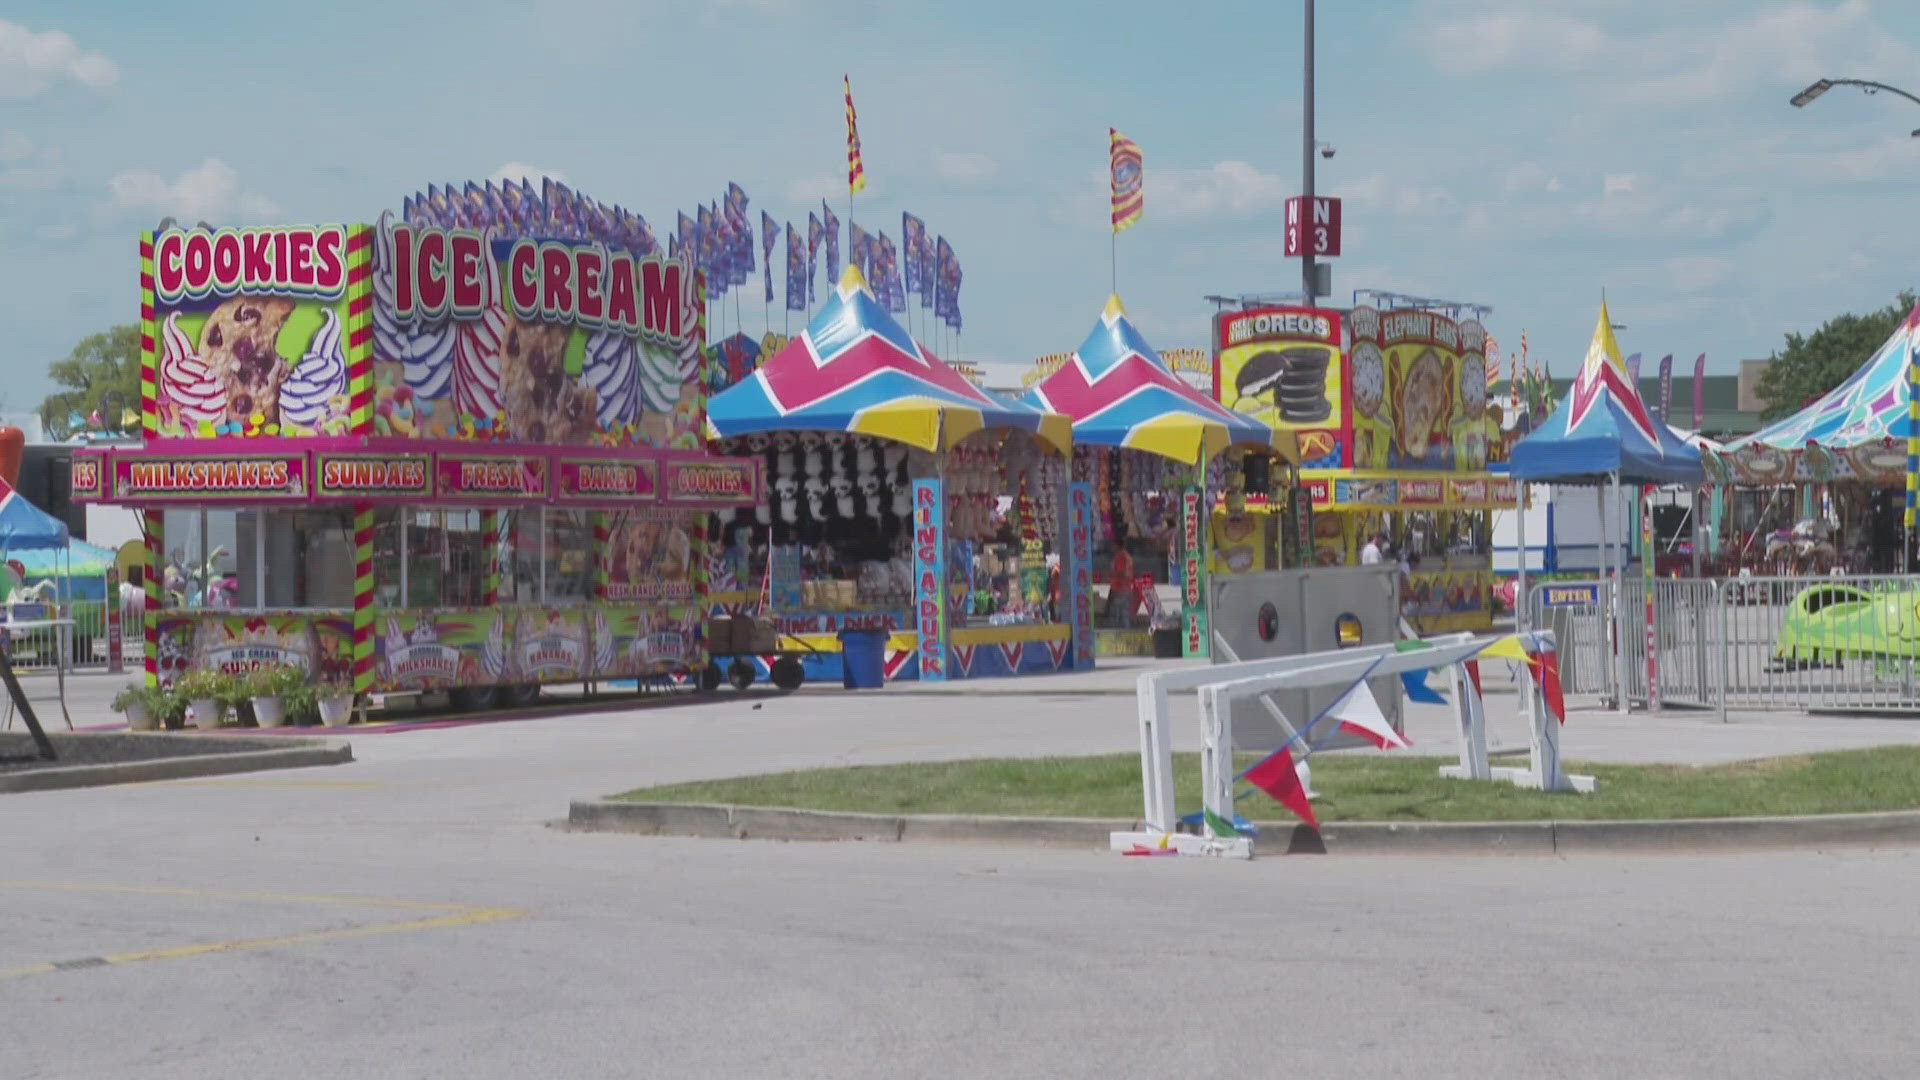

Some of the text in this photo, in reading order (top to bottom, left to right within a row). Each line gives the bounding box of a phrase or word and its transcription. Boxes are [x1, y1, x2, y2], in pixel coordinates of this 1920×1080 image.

[1288, 200, 1298, 225] N
[1313, 199, 1330, 225] N
[1288, 229, 1297, 253] 3
[1314, 228, 1329, 252] 3
[157, 227, 344, 297] COOKIES
[392, 224, 683, 346] ICE CREAM
[1254, 314, 1329, 338] OREOS
[1383, 313, 1458, 350] ELEPHANT EARS
[131, 460, 289, 489] MILKSHAKES
[324, 461, 425, 488] SUNDAES
[578, 465, 637, 491] BAKED
[677, 467, 742, 493] COOKIES
[917, 486, 936, 565] RING
[1549, 589, 1593, 604] ENTER
[920, 600, 941, 676] DUCK
